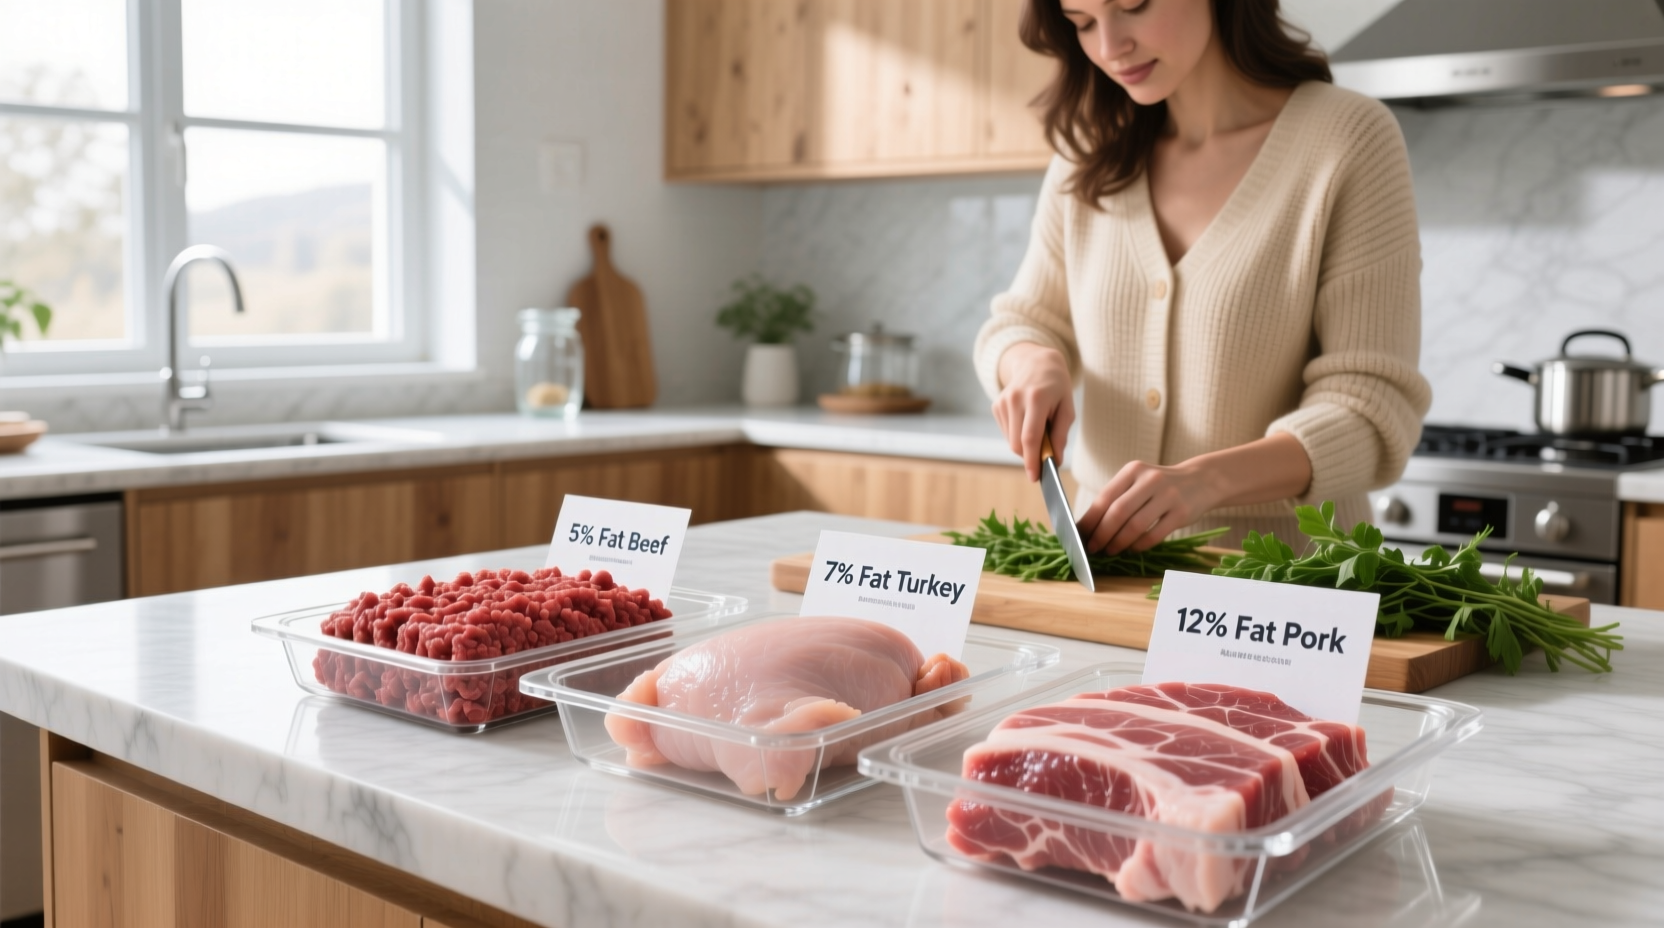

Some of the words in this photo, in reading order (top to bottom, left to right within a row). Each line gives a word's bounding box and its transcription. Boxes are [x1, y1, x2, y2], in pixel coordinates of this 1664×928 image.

[569, 523, 594, 545] 5%
[599, 527, 625, 550] Fat
[628, 532, 670, 555] Beef
[824, 560, 854, 585] 7%
[858, 565, 892, 590] Fat
[897, 570, 966, 605] Turkey
[1177, 607, 1228, 638] 12%
[1235, 615, 1277, 644] Fat
[1282, 622, 1347, 654] Pork
